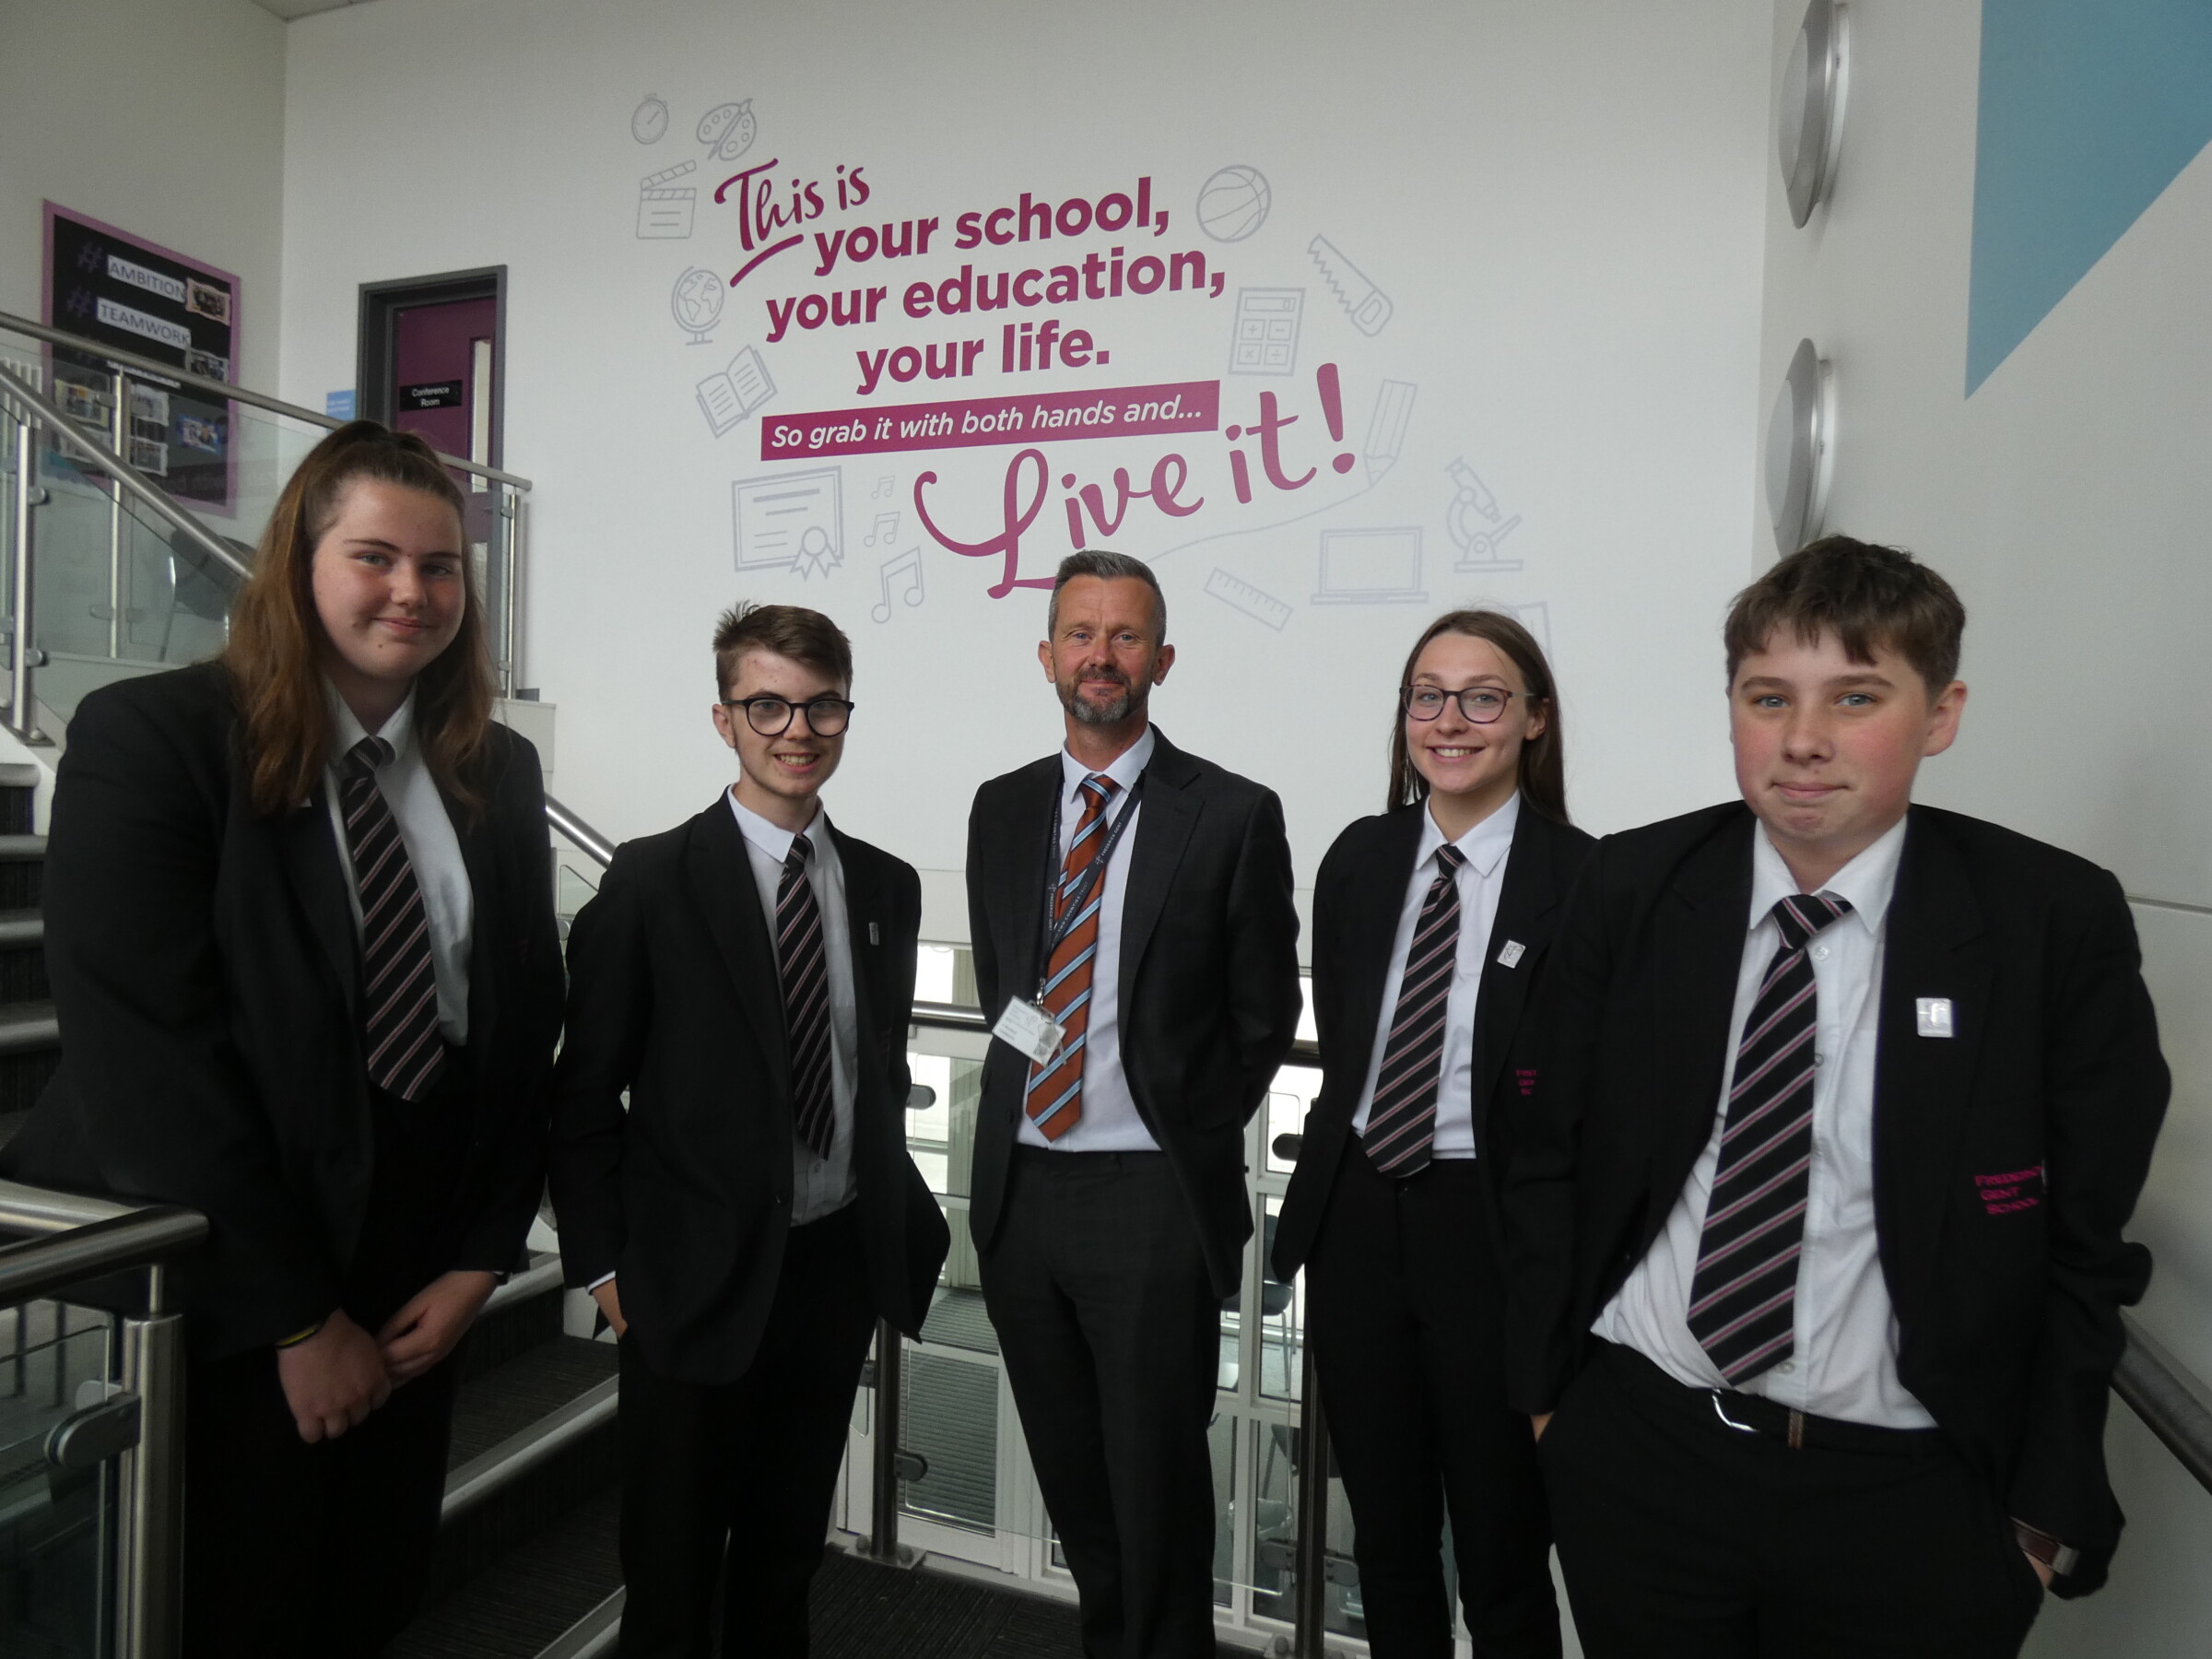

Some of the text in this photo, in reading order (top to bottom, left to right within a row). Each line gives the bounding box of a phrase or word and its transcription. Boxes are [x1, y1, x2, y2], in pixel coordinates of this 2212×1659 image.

[715, 159, 870, 252] This is
[815, 176, 1170, 276] your school,
[110, 262, 187, 300] AMBITION
[766, 246, 1225, 343] your education,
[100, 303, 192, 347] TEAMWORK
[856, 319, 1111, 395] your life.
[411, 385, 451, 398] Conference
[420, 398, 441, 407] Room
[771, 394, 1202, 450] So grab it with both hands and...
[914, 363, 1354, 599] Live it!
